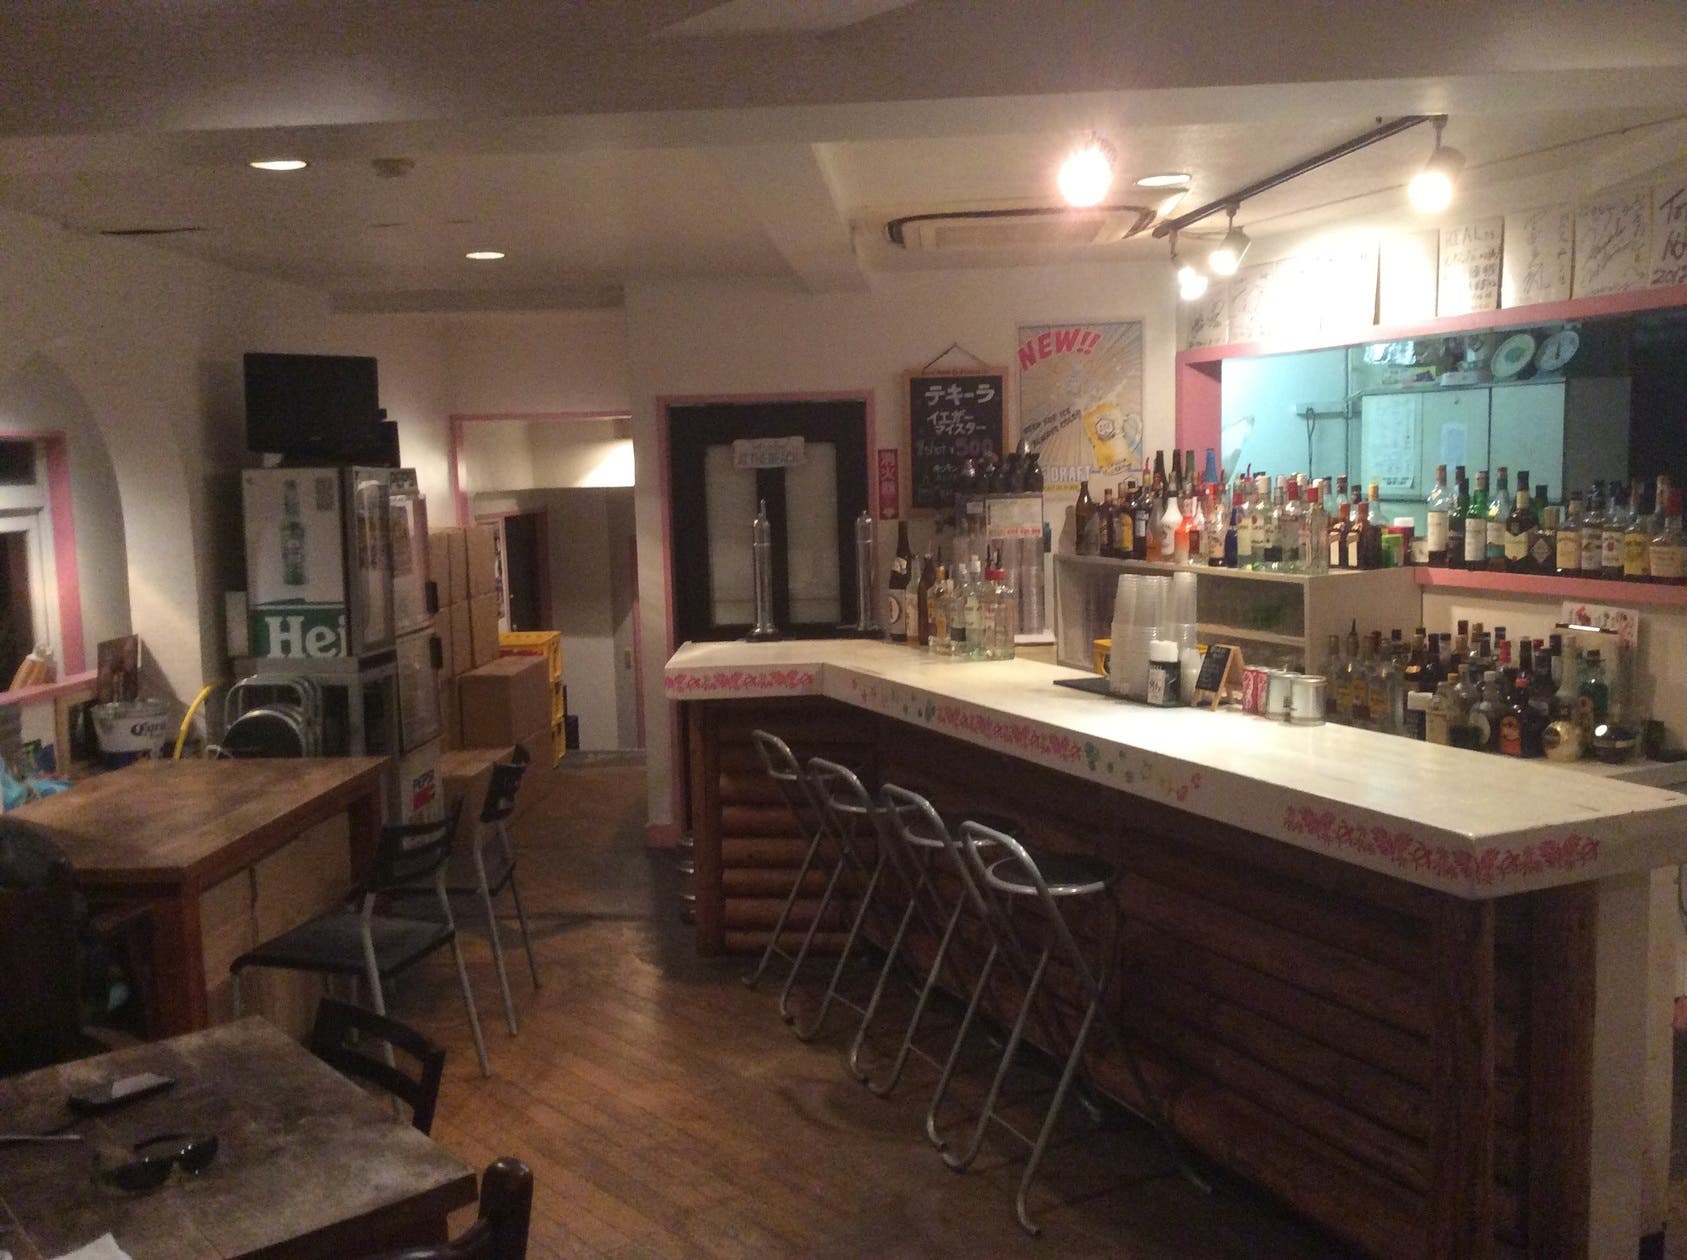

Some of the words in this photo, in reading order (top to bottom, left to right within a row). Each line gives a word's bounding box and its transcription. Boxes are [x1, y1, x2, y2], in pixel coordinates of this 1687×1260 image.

[1018, 328, 1102, 371] NEW!!
[925, 384, 995, 406] テキーラ
[934, 422, 987, 436] マイスター
[264, 615, 347, 658] Hei
